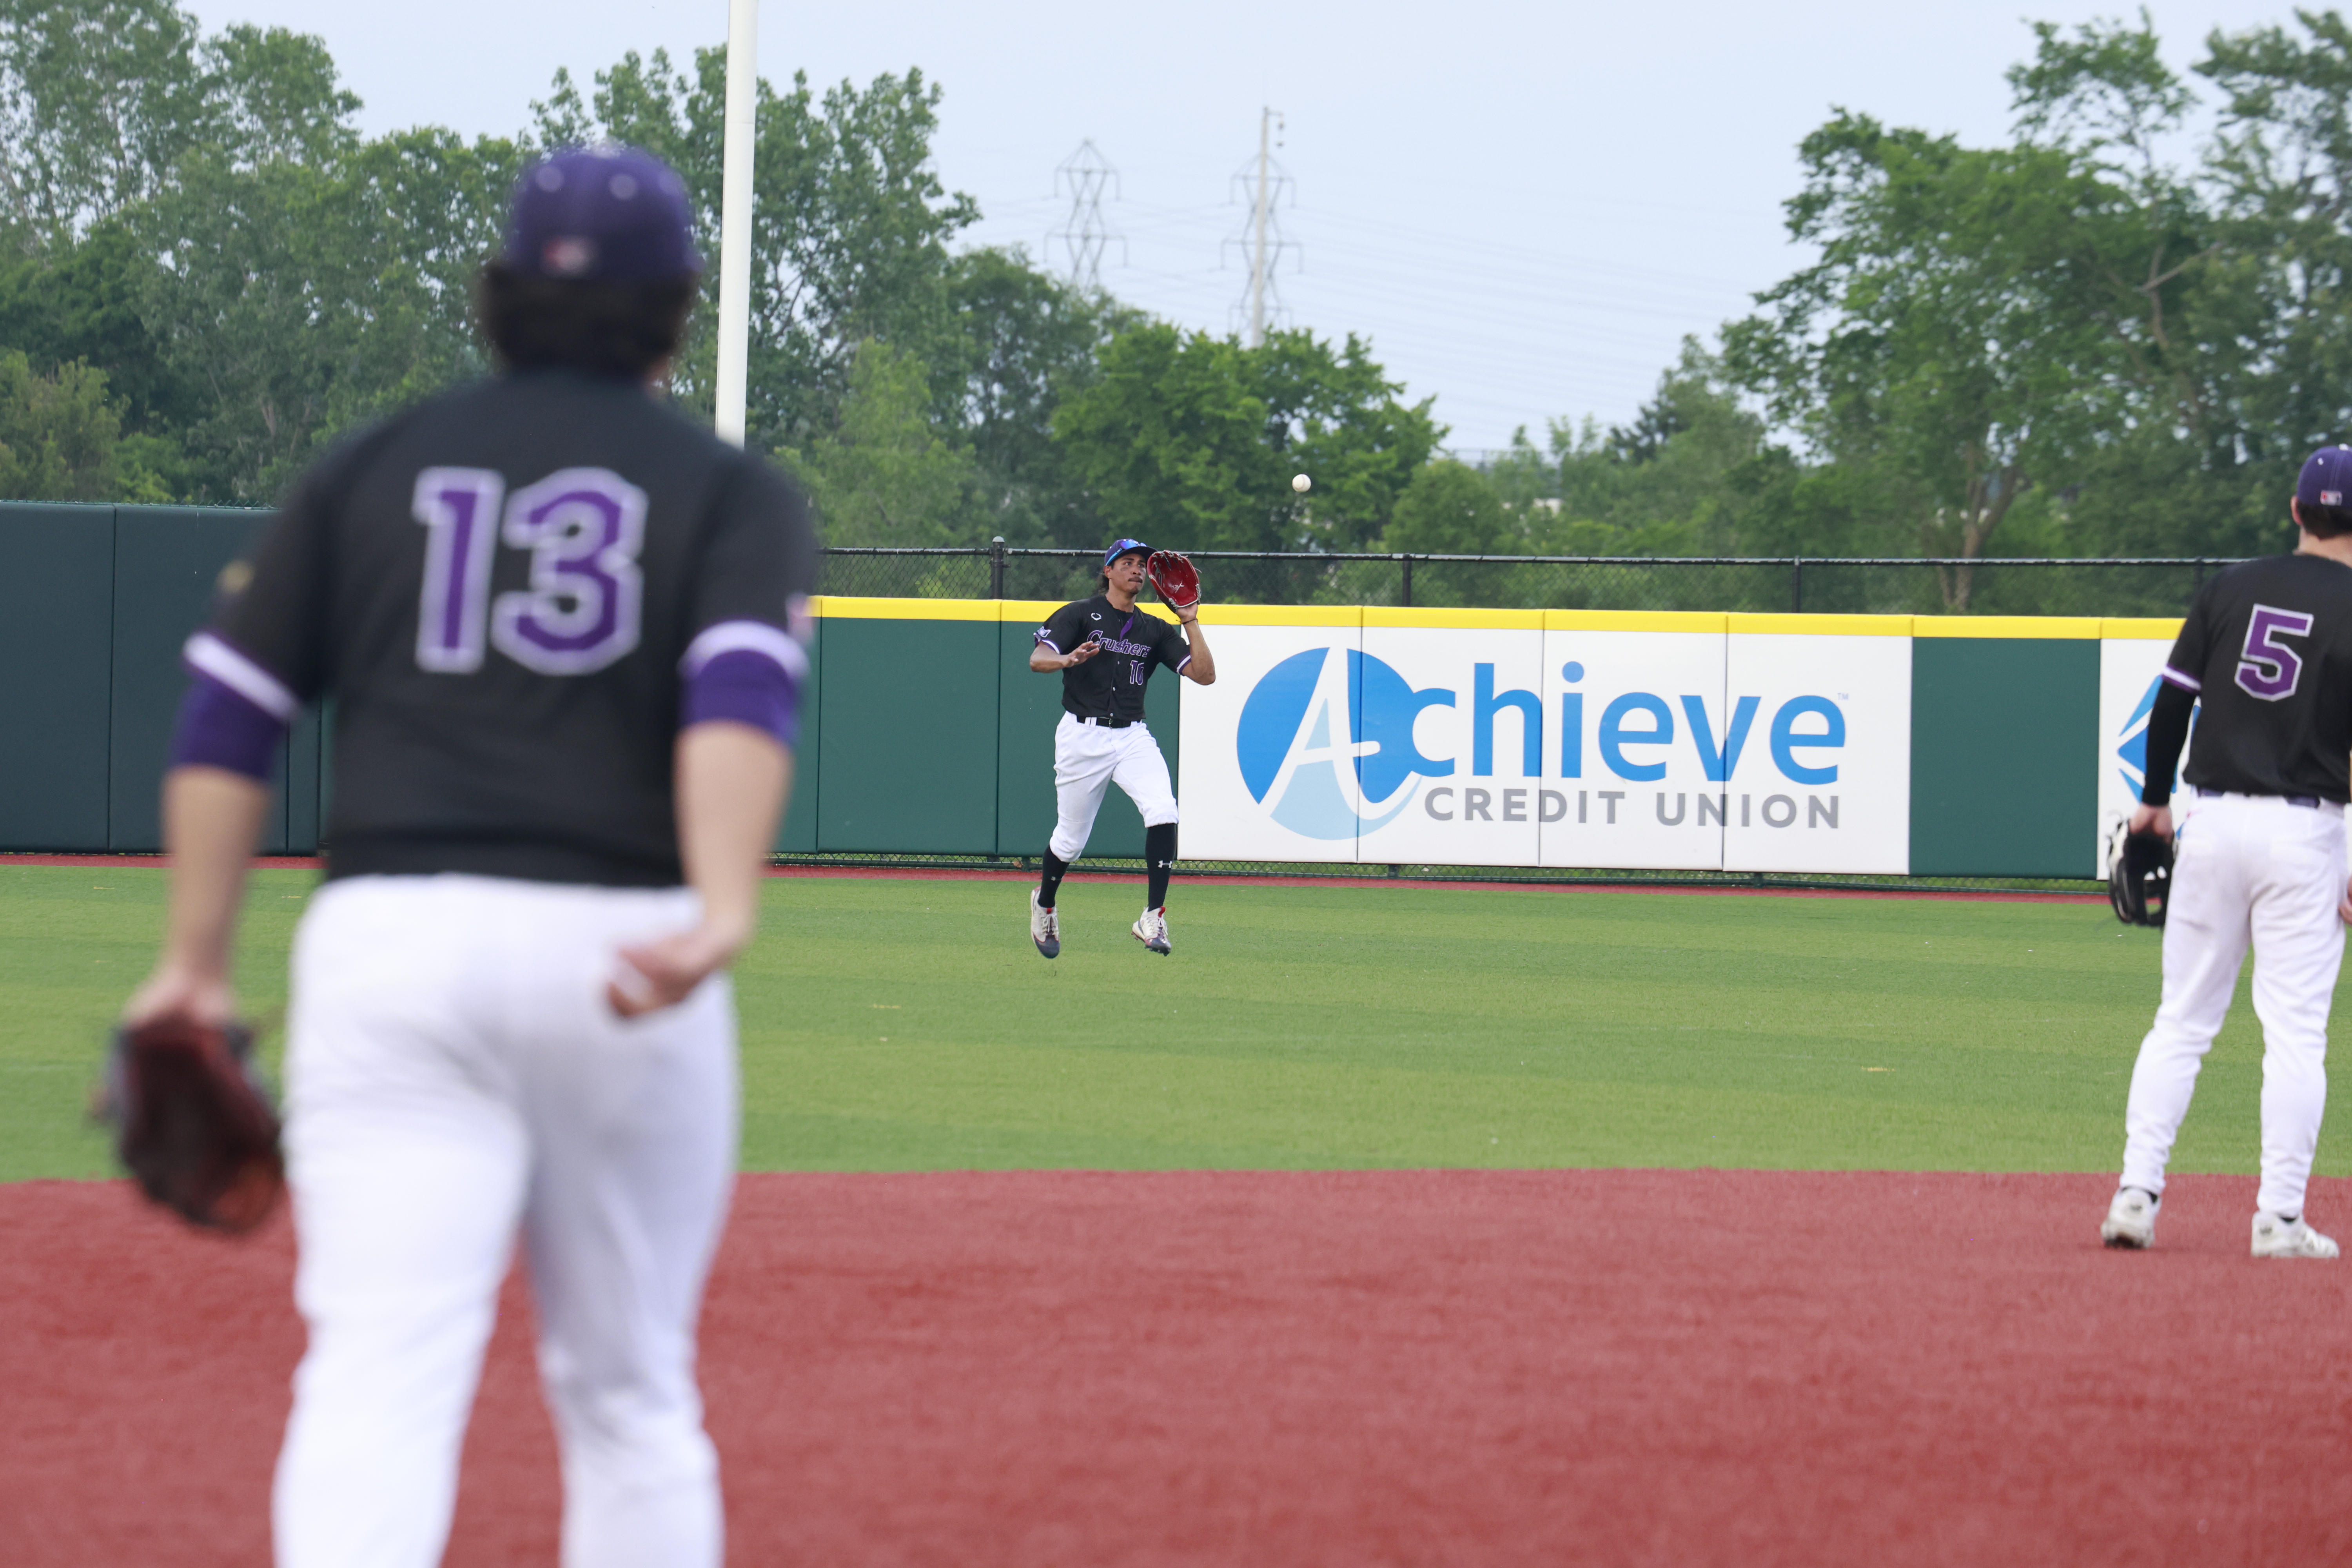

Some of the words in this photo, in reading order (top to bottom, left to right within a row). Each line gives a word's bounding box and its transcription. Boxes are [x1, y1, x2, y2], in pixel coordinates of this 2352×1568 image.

[412, 466, 649, 676] 13
[1087, 630, 1151, 657] Crushers
[1130, 660, 1145, 685] 10
[2235, 604, 2314, 701] 5
[1254, 647, 1846, 821] Achieve
[1425, 787, 1625, 824] CREDIT
[1656, 793, 1838, 829] UNION
